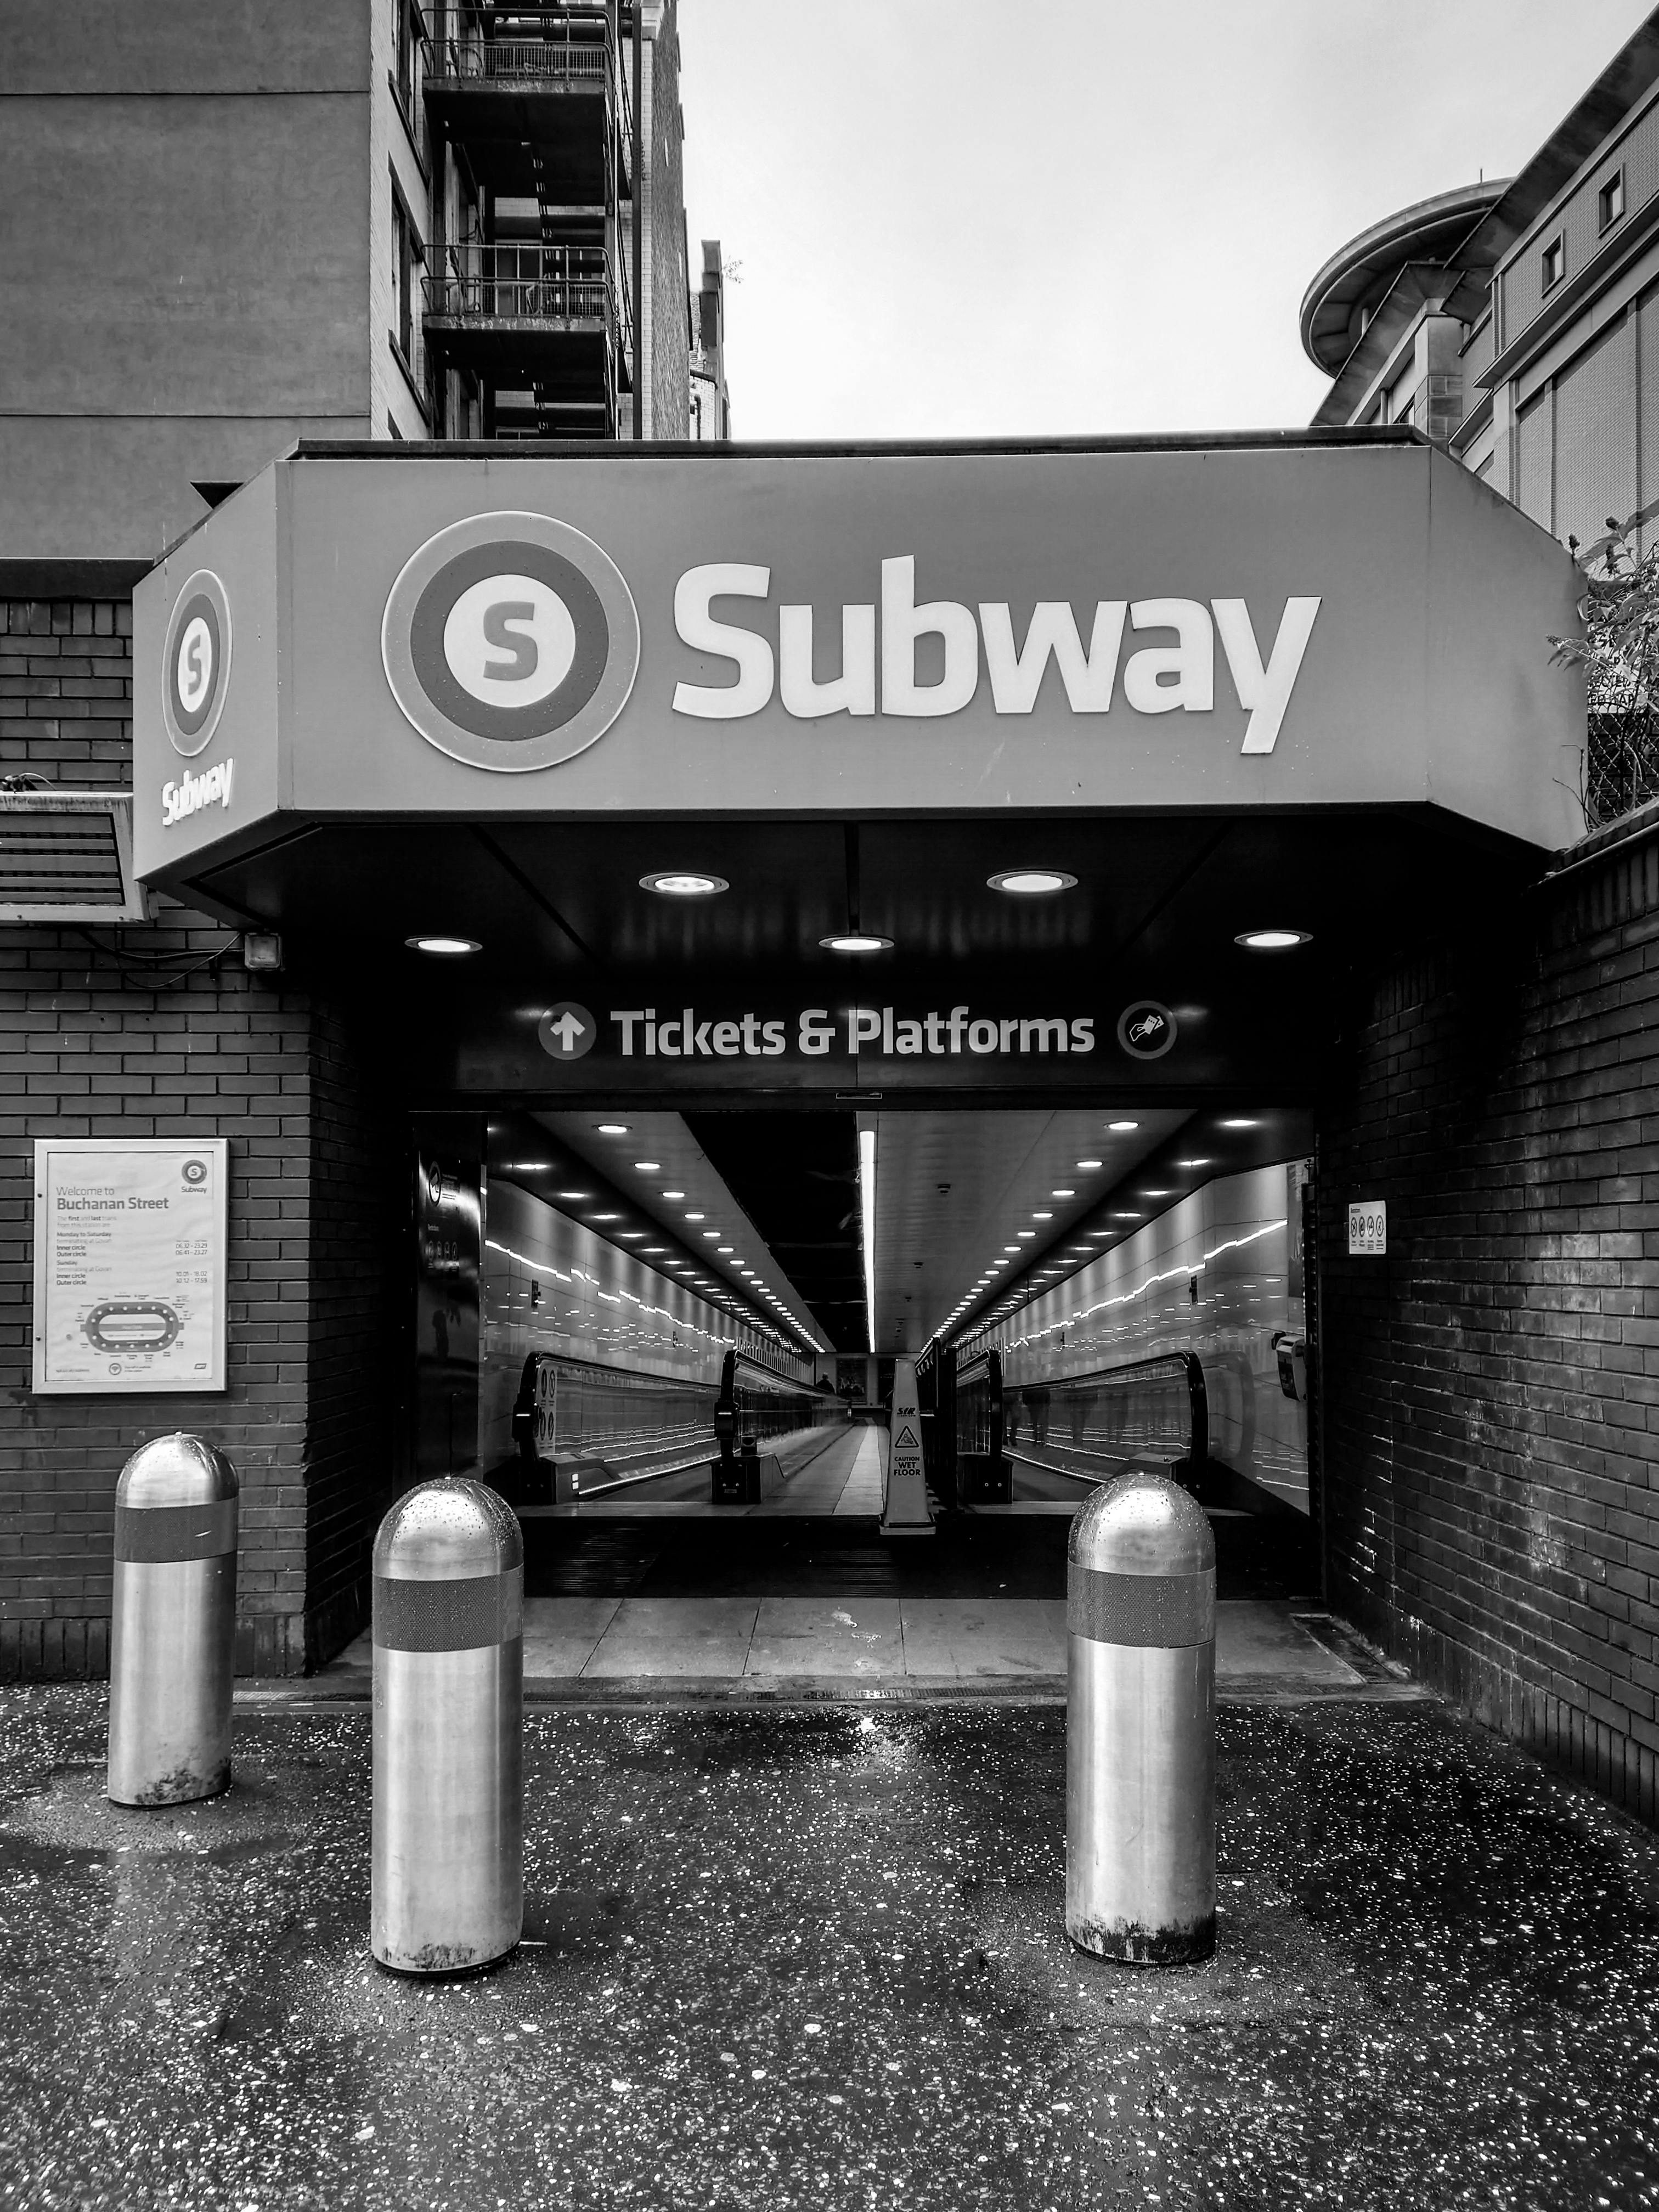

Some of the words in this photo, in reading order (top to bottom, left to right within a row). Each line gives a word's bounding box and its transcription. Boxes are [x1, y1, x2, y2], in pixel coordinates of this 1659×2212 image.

[483, 601, 539, 682] S
[672, 555, 1322, 755] Subway
[162, 758, 234, 826] Subway
[610, 1008, 786, 1057] Tickets
[799, 1009, 835, 1055] &
[848, 1006, 1095, 1054] Platforms
[56, 1187, 103, 1196] Welcome
[104, 1187, 115, 1196] to
[57, 1197, 125, 1210] Buchanan
[128, 1197, 169, 1209] Street
[181, 1186, 207, 1194] Subway
